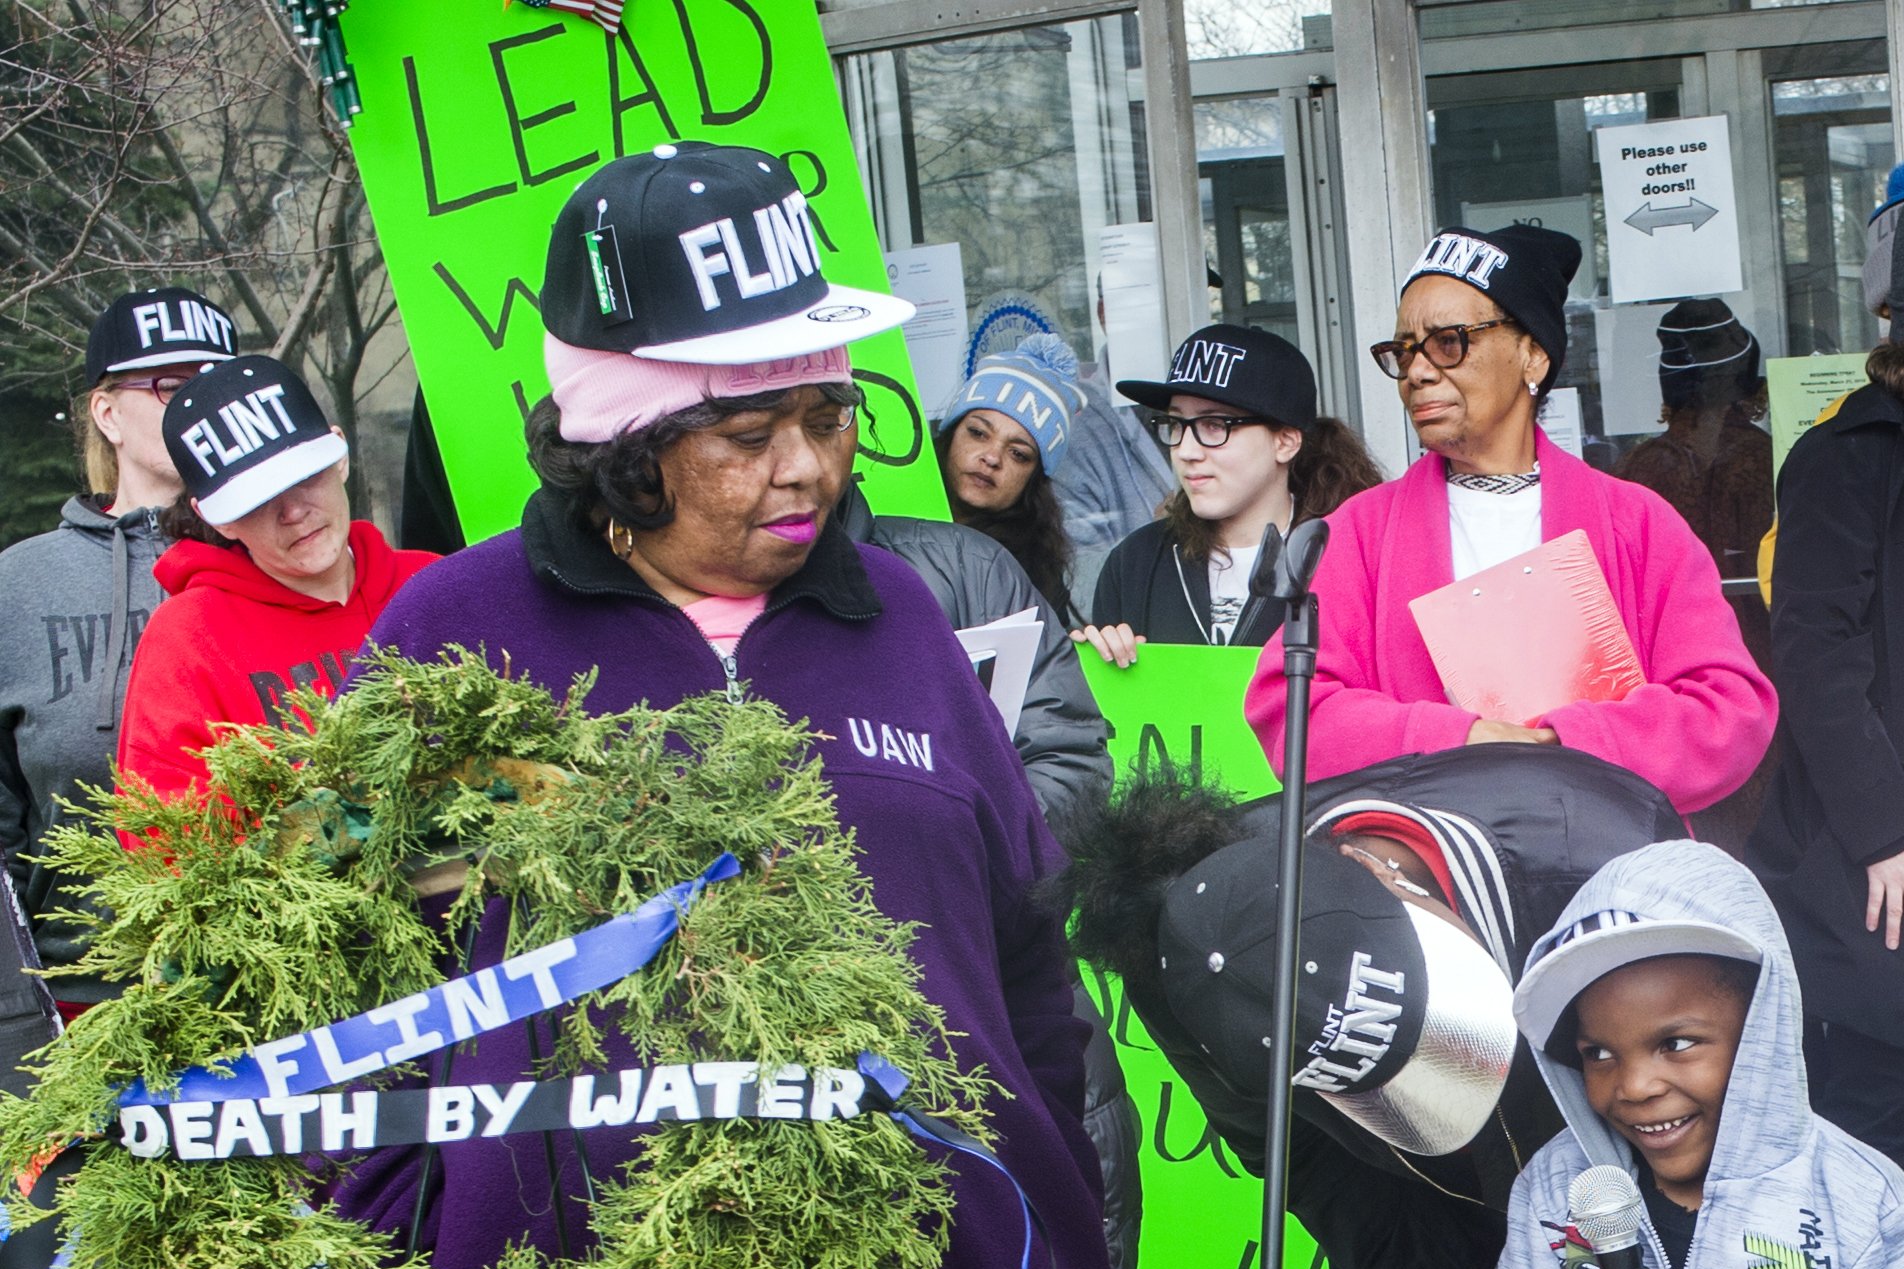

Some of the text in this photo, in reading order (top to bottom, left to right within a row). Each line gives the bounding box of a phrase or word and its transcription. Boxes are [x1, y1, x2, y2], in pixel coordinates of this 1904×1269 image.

[403, 0, 772, 217] LEAD
[1622, 141, 1707, 160] Please use
[1646, 162, 1688, 176] other
[1641, 178, 1695, 196] doors!!
[679, 190, 821, 311] FLINT
[132, 300, 233, 354] FLINT
[180, 383, 298, 478] FLINT
[953, 381, 1066, 452] LINT
[847, 717, 935, 772] UAW
[252, 937, 577, 1098] FLINT
[1291, 951, 1405, 1092] FLINT
[1307, 1003, 1344, 1056] FLINT
[120, 1061, 866, 1160] DEATH BY WATER
